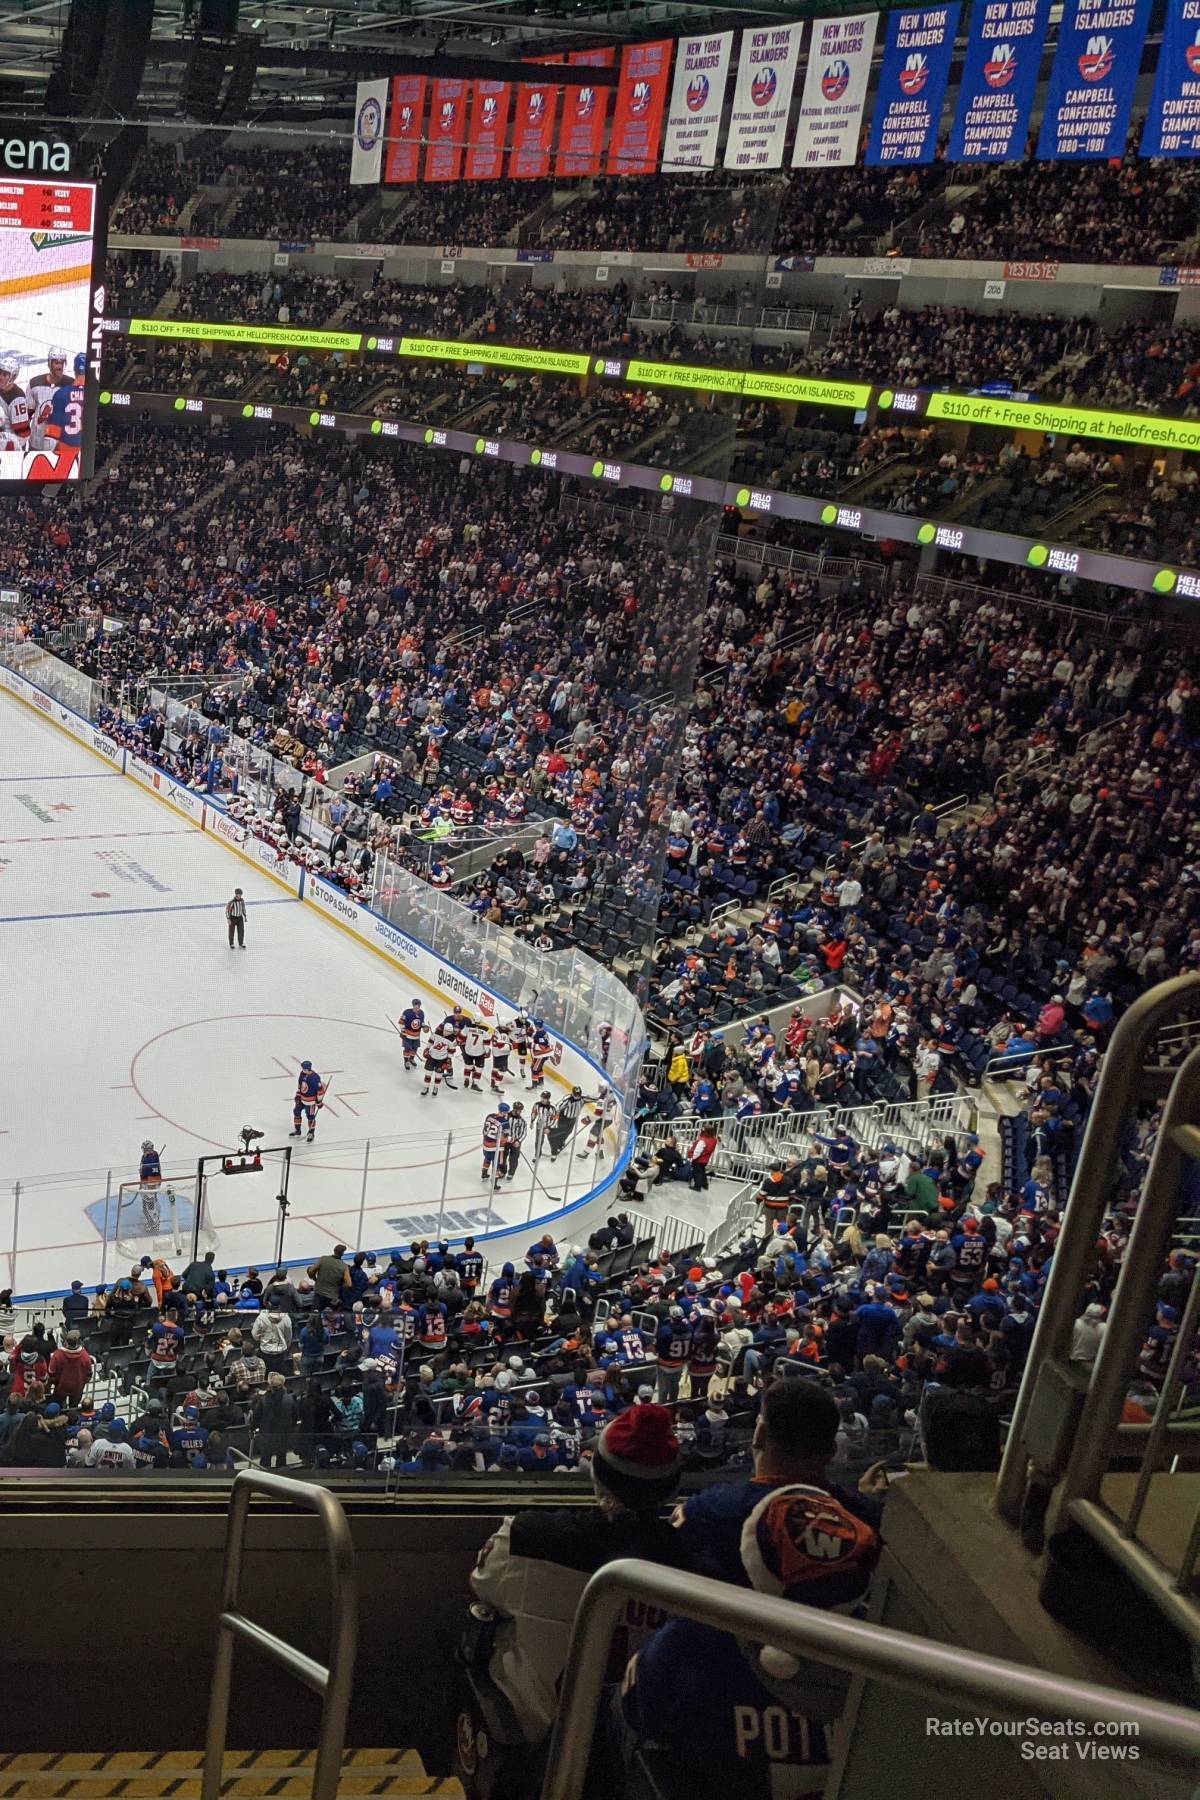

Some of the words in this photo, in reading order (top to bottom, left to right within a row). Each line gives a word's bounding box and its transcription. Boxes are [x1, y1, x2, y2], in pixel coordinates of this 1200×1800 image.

[986, 4, 1008, 20] NEW
[1011, 0, 1038, 17] YORK
[900, 15, 920, 30] NEW
[923, 10, 947, 26] YORK
[1075, 9, 1134, 30] ISLANDERS
[823, 25, 840, 40] NEW
[844, 20, 866, 36] YORK
[982, 18, 1034, 38] ISLANDERS
[752, 34, 768, 47] NEW
[770, 30, 792, 44] YORK
[896, 29, 944, 48] ISLANDERS
[686, 42, 702, 55] NEW
[704, 39, 722, 53] YORK
[820, 38, 862, 56] ISLANDERS
[685, 55, 720, 70] ISLANDERS
[750, 48, 788, 64] ISLANDERS
[972, 94, 1015, 108] CAMPBELL
[1066, 88, 1114, 104] CAMPBELL
[824, 105, 842, 116] HOCKEY
[890, 100, 927, 114] CAMPBELL
[1058, 104, 1118, 120] CONFERENCE
[883, 115, 930, 129] CONFERENCE
[965, 109, 1018, 124] CONFERENCE
[965, 126, 1012, 140] CHAMPIONS
[1057, 122, 1111, 137] CHAMPIONS
[742, 139, 768, 148] CHAMPIONS
[812, 136, 839, 145] CHAMPIONS
[882, 131, 925, 144] CHAMPIONS
[1008, 263, 1023, 277] YES
[1024, 263, 1040, 277] YES
[1040, 262, 1057, 278] YES
[141, 324, 158, 332] $110
[160, 325, 174, 333] OFF
[182, 326, 200, 335] FREE
[201, 327, 235, 338] SHIPPING
[236, 329, 246, 338] AT
[638, 368, 653, 377] $110
[654, 370, 668, 378] OFF
[674, 372, 690, 382] FREE
[692, 372, 724, 386] SHIPPING
[726, 377, 736, 387] AT
[895, 393, 917, 402] HELLO
[14, 402, 26, 416] 16
[893, 400, 916, 411] FRESH
[942, 402, 970, 416] $110
[972, 404, 992, 418] off
[1003, 410, 1030, 424] Free
[1033, 412, 1087, 434] Shipping
[1090, 421, 1104, 432] at
[604, 465, 620, 474] HELLO
[672, 484, 690, 494] FRESH
[674, 478, 692, 487] HELLO
[752, 492, 771, 503] HELLO
[750, 500, 770, 510] FRESH
[836, 517, 860, 528] FRESH
[838, 510, 861, 521] HELLO
[938, 528, 963, 540] HELLO
[936, 536, 961, 548] FRESH
[1050, 550, 1078, 564] HELLO
[1048, 559, 1078, 572] FRESH
[93, 734, 118, 760] verizon
[315, 885, 358, 922] STOP&SHOP
[438, 967, 478, 1004] guaranteed
[480, 992, 495, 1012] Rate
[472, 1032, 480, 1046] 7
[484, 1126, 498, 1137] 32
[384, 1207, 508, 1238] DIME
[960, 1251, 982, 1266] 53
[464, 1264, 476, 1278] 11
[200, 1314, 215, 1324] 44
[427, 1318, 445, 1336] 13
[156, 1338, 178, 1356] 27
[623, 1340, 645, 1360] 13
[670, 1340, 690, 1358] 91
[498, 1400, 510, 1408] LEE
[181, 1440, 203, 1448] GILLIES
[104, 1451, 122, 1460] SMITH
